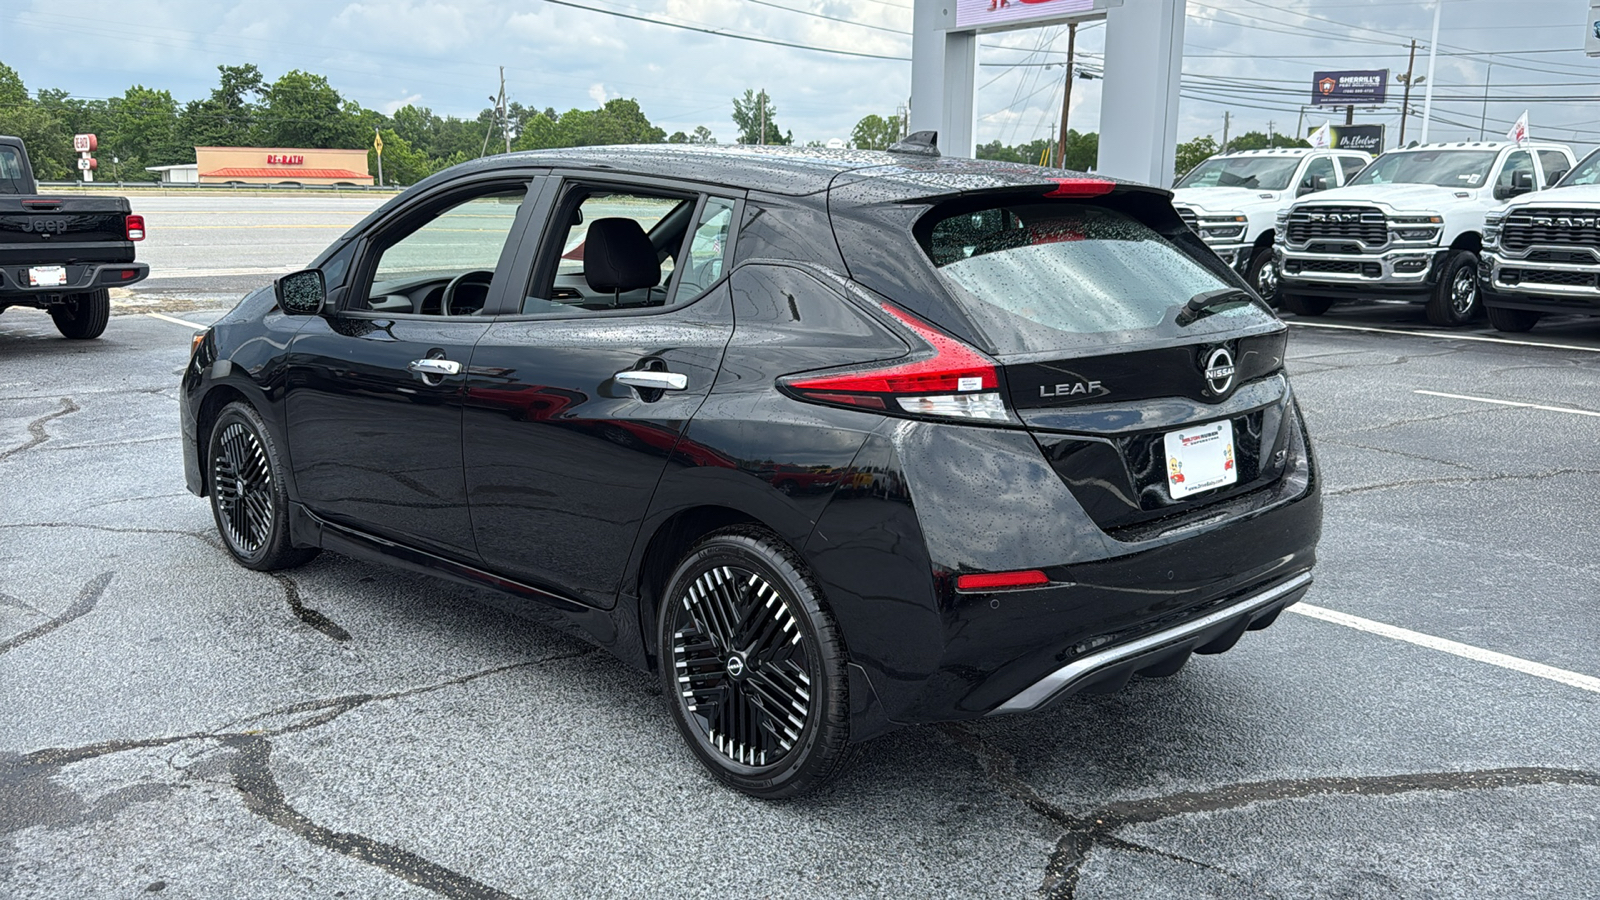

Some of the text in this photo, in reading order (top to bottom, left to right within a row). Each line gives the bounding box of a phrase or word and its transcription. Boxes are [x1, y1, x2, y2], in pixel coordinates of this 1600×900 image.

[1311, 213, 1359, 223] RAM
[1533, 217, 1595, 227] RAM
[22, 216, 67, 234] Jeep
[1040, 381, 1102, 397] LEAF
